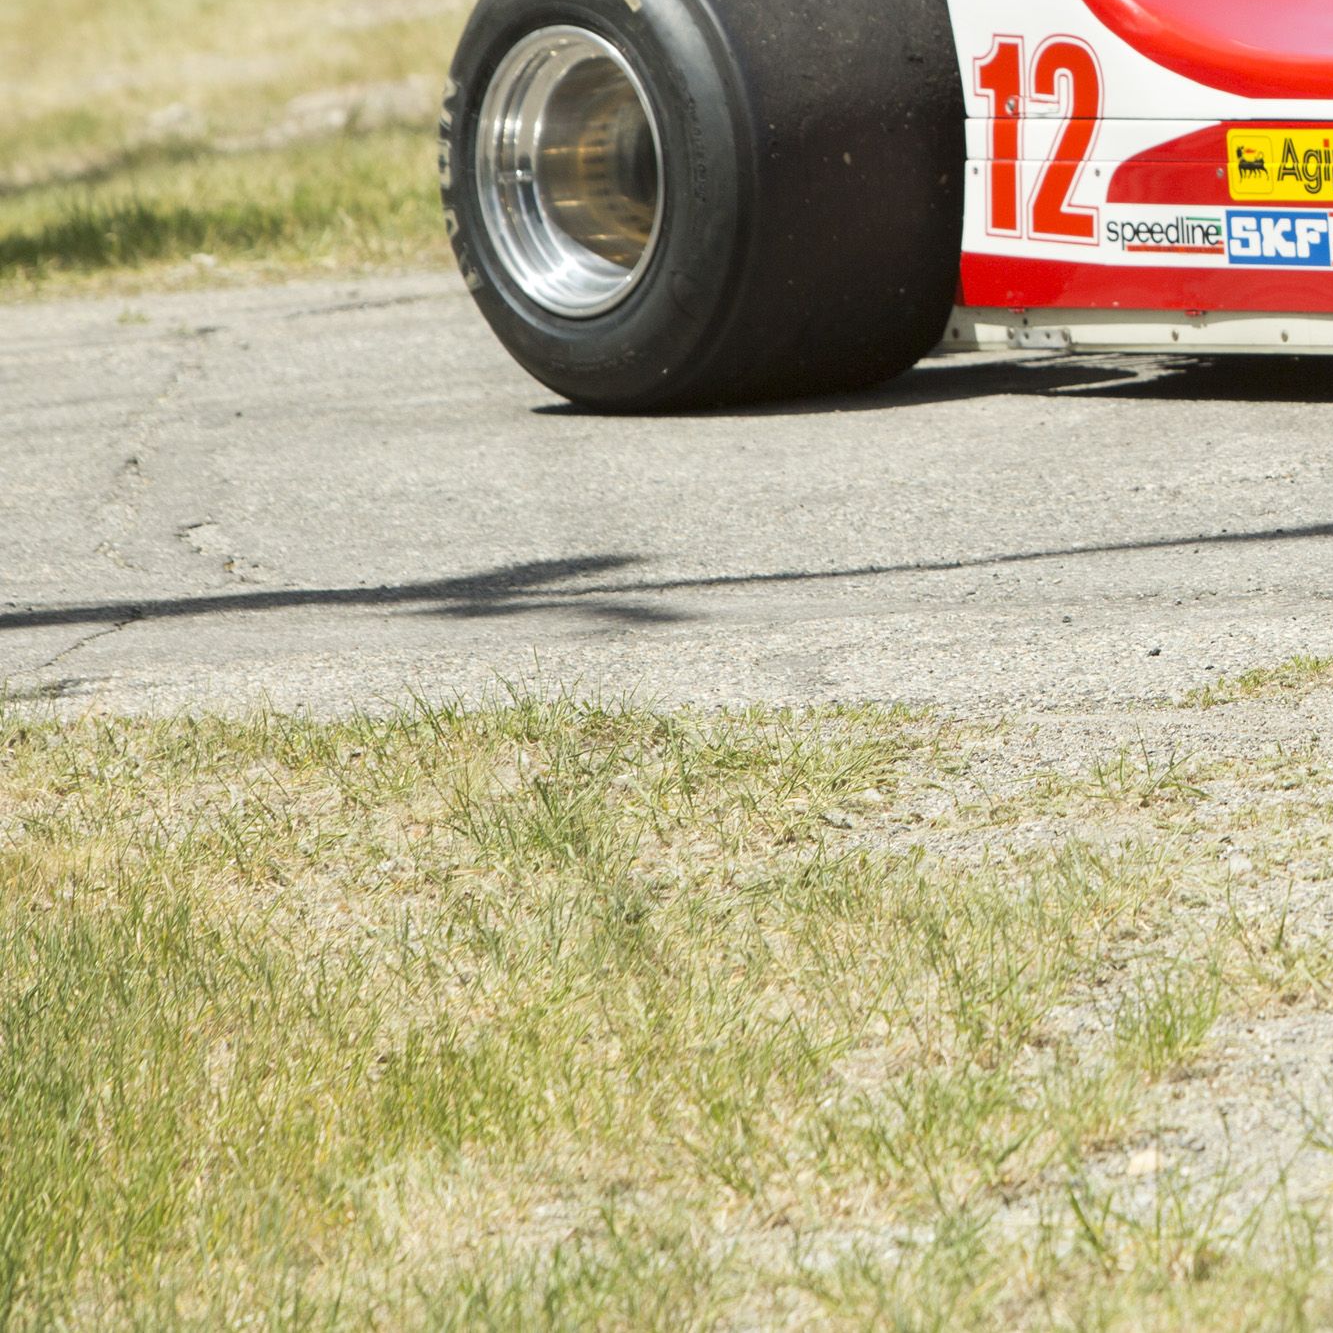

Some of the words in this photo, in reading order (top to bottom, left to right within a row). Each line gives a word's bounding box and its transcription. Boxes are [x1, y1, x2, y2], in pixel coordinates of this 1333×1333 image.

[972, 33, 1105, 246] 12
[1106, 216, 1220, 250] speedline
[1230, 217, 1328, 258] SKF
